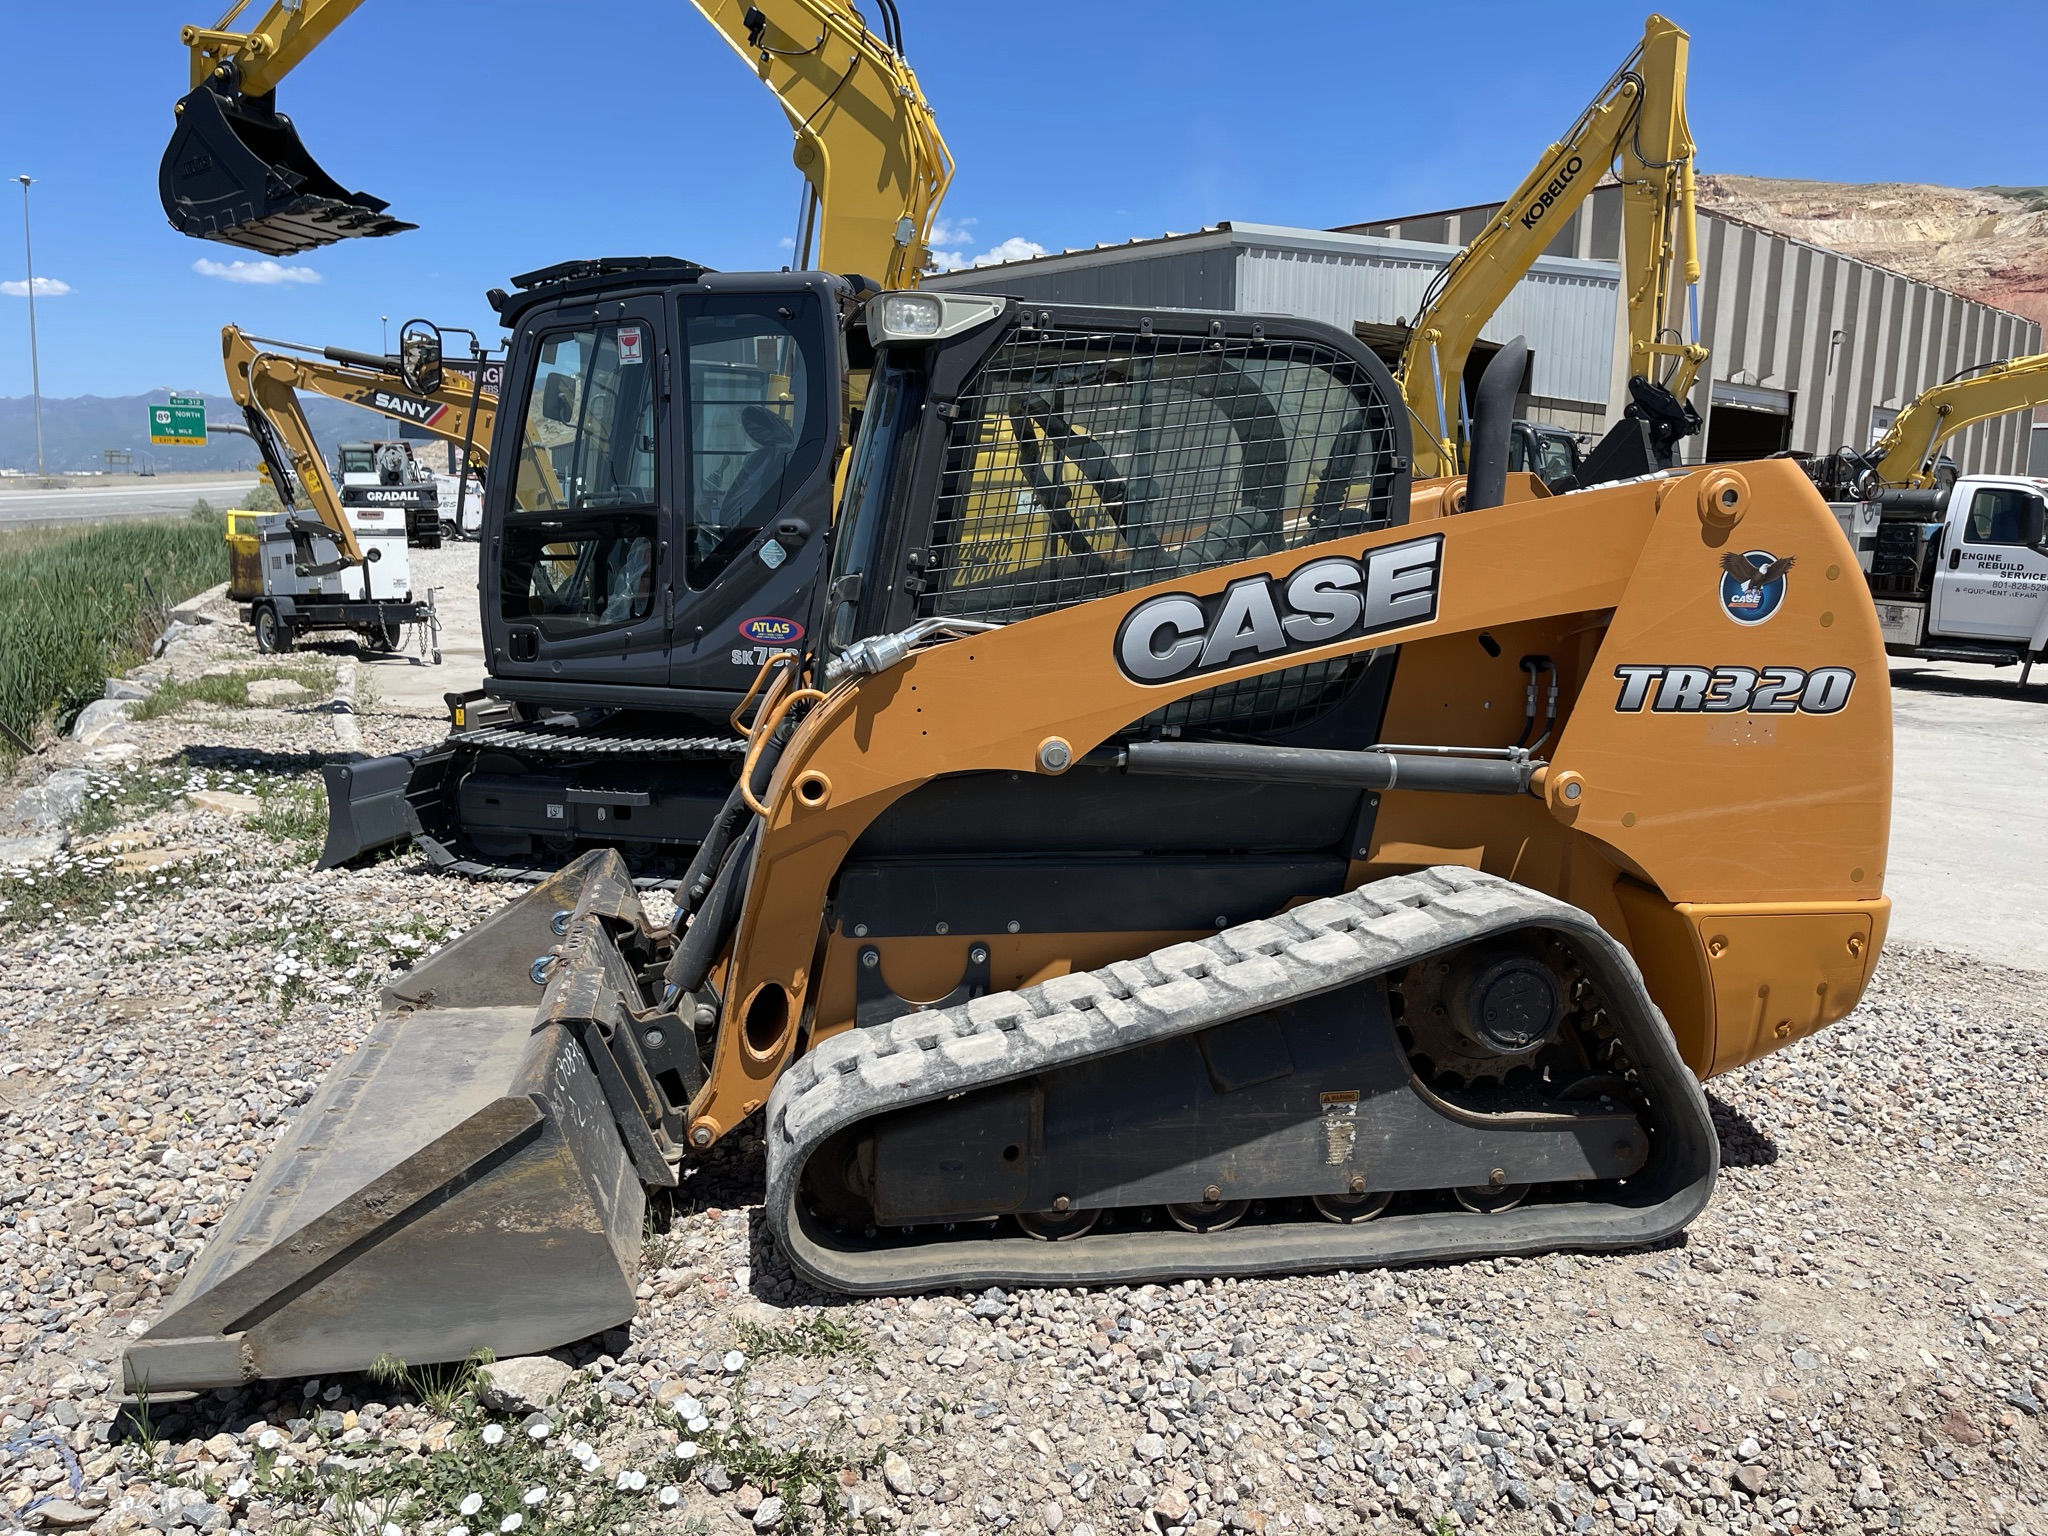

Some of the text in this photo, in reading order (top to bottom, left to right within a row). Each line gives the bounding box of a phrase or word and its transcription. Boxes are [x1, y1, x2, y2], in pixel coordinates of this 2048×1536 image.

[1520, 156, 1583, 231] KOBELCO
[375, 393, 431, 418] SANY
[158, 410, 201, 421] 89 NORTH
[366, 491, 420, 501] GRADALL
[1961, 552, 2003, 562] ENGINE
[1977, 561, 2025, 571] REBUILD
[1999, 570, 2048, 581] SERVICE
[1731, 594, 1761, 604] CASE
[1115, 534, 1443, 686] CASE
[751, 622, 790, 634] ATLAS
[1615, 665, 1855, 716] TR320
[1331, 1093, 1356, 1101] WARNING
